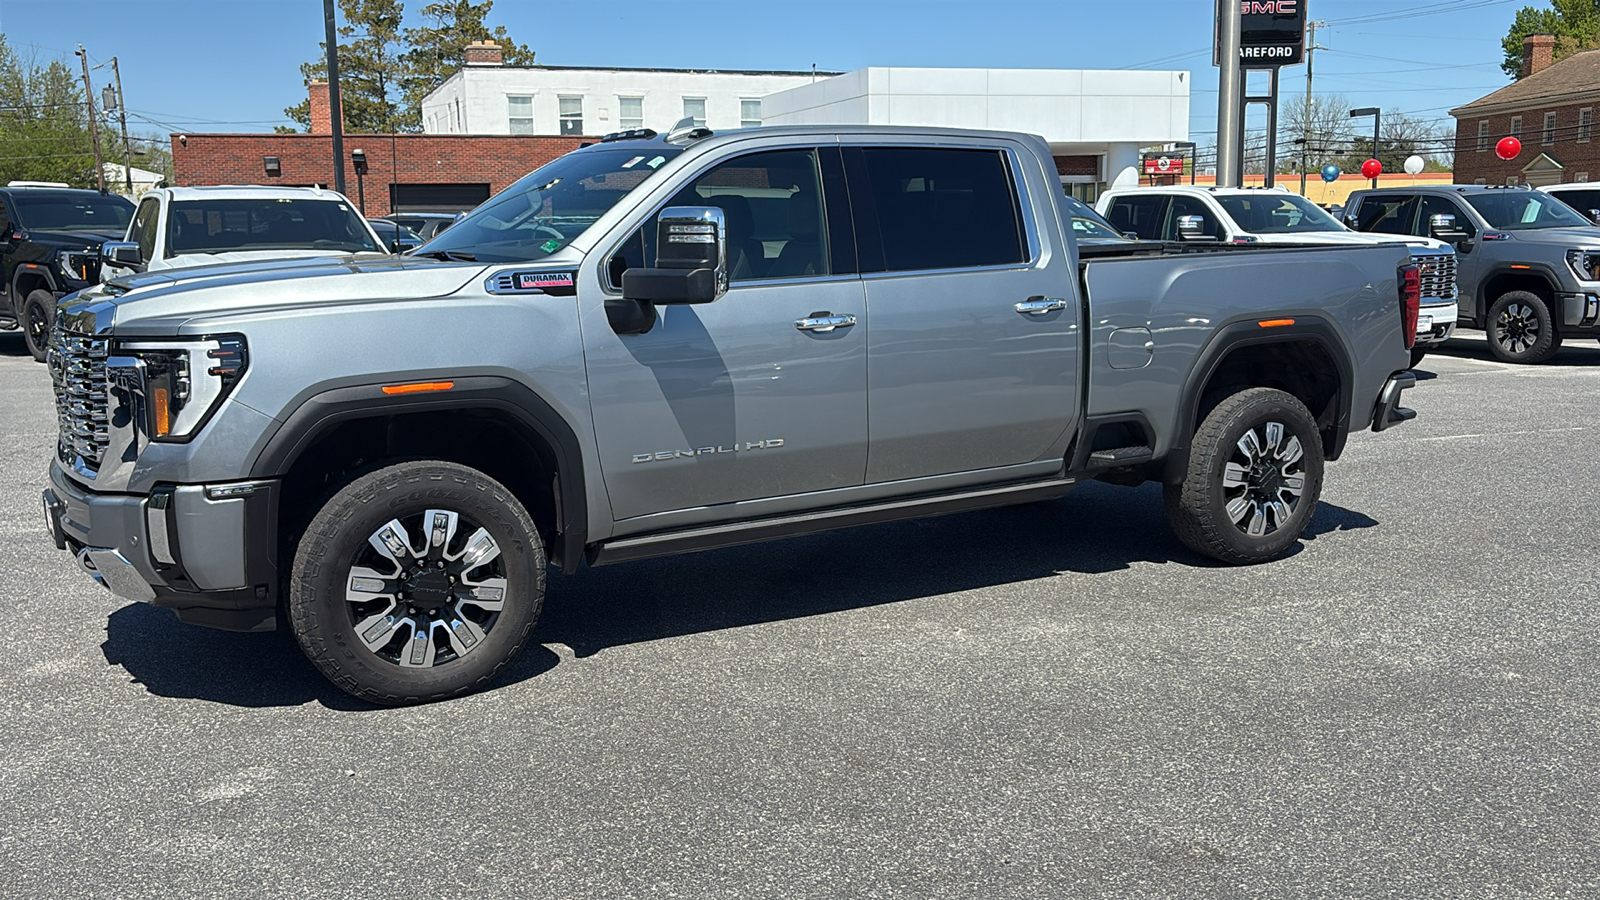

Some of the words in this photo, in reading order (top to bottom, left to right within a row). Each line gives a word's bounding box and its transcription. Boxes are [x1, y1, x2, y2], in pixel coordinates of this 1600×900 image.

[523, 273, 570, 283] DURAMAX
[632, 443, 739, 464] DENALI
[746, 438, 784, 450] HD
[389, 489, 522, 552] GOODYEAR
